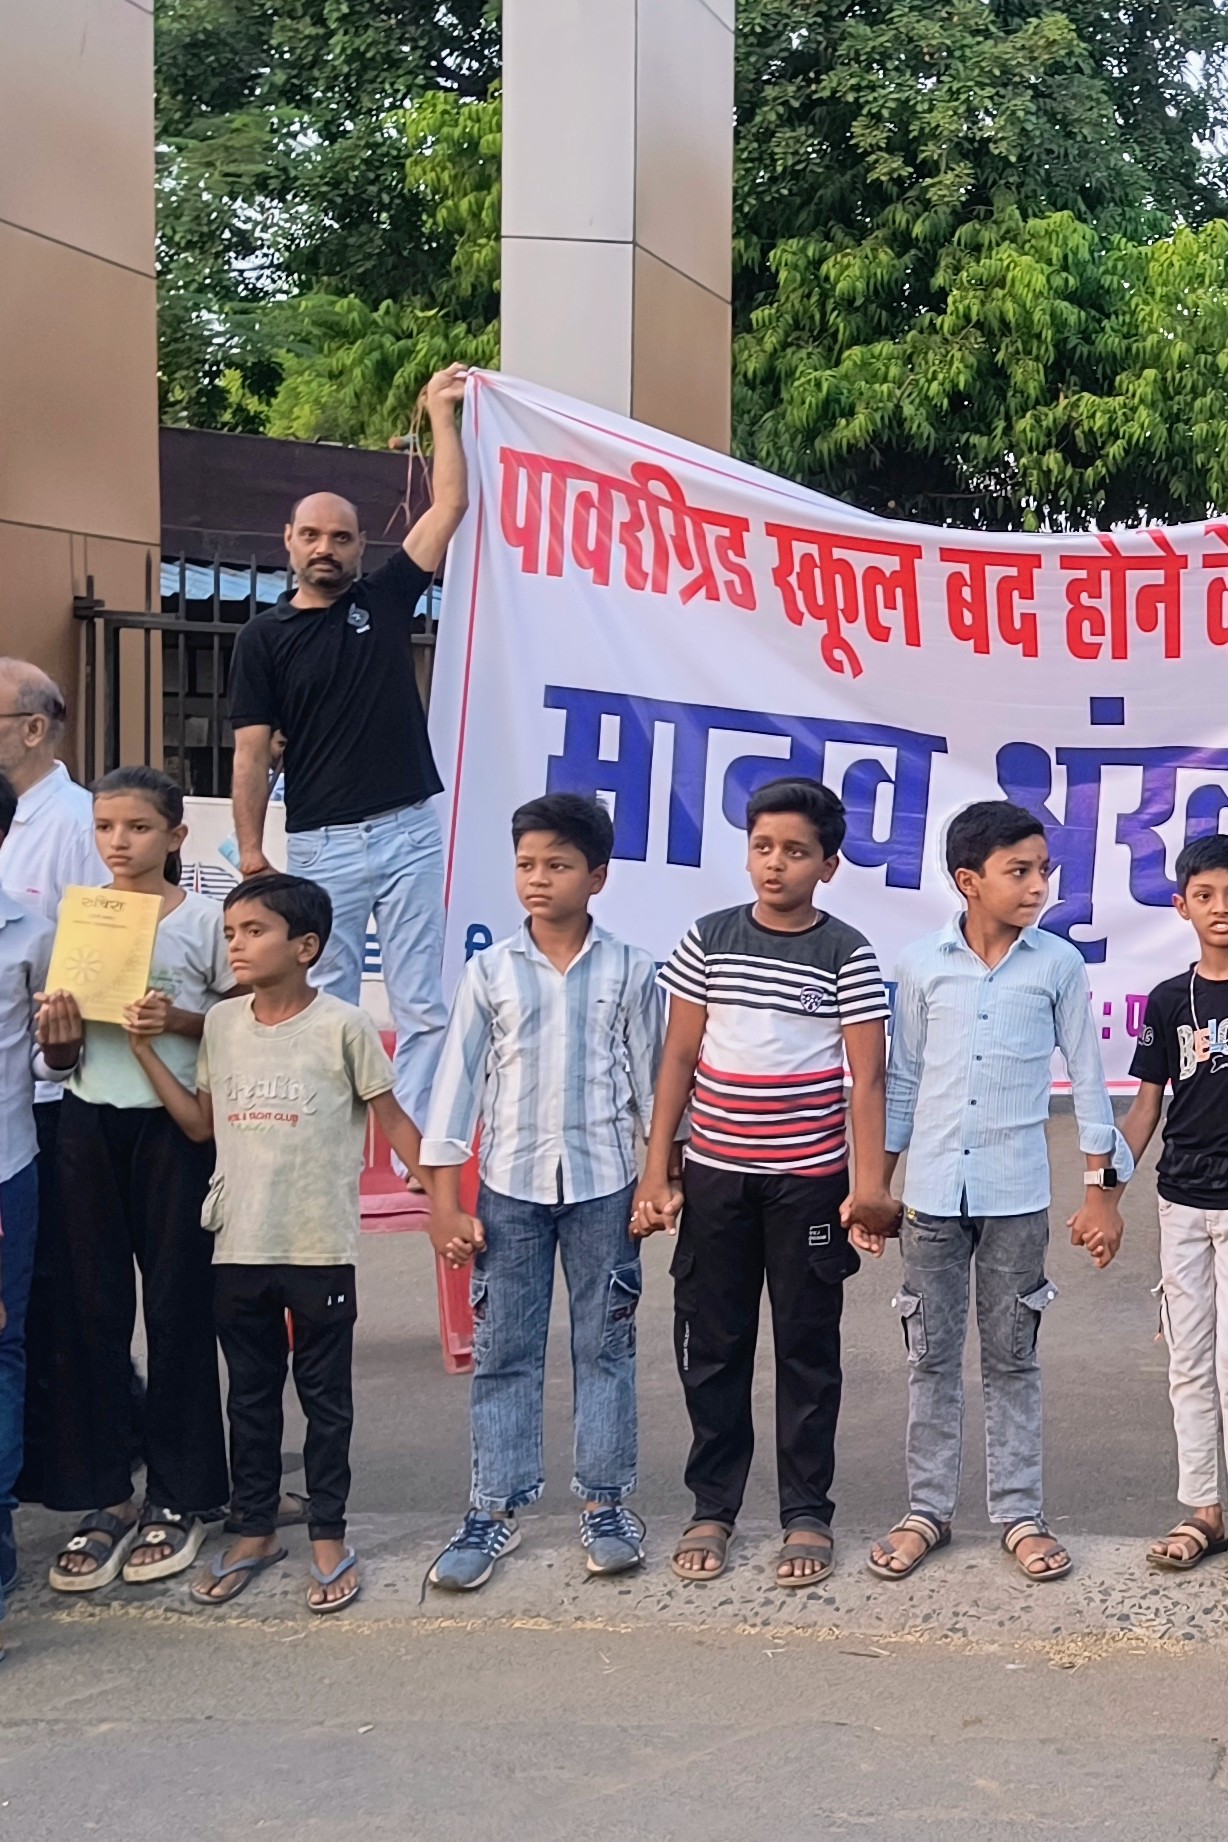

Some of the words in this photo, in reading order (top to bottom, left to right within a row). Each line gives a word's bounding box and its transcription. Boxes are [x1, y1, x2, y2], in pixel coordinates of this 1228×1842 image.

[500, 445, 757, 612] पावरग्रिड
[764, 521, 922, 679] स्कूल
[1059, 528, 1188, 660] होने
